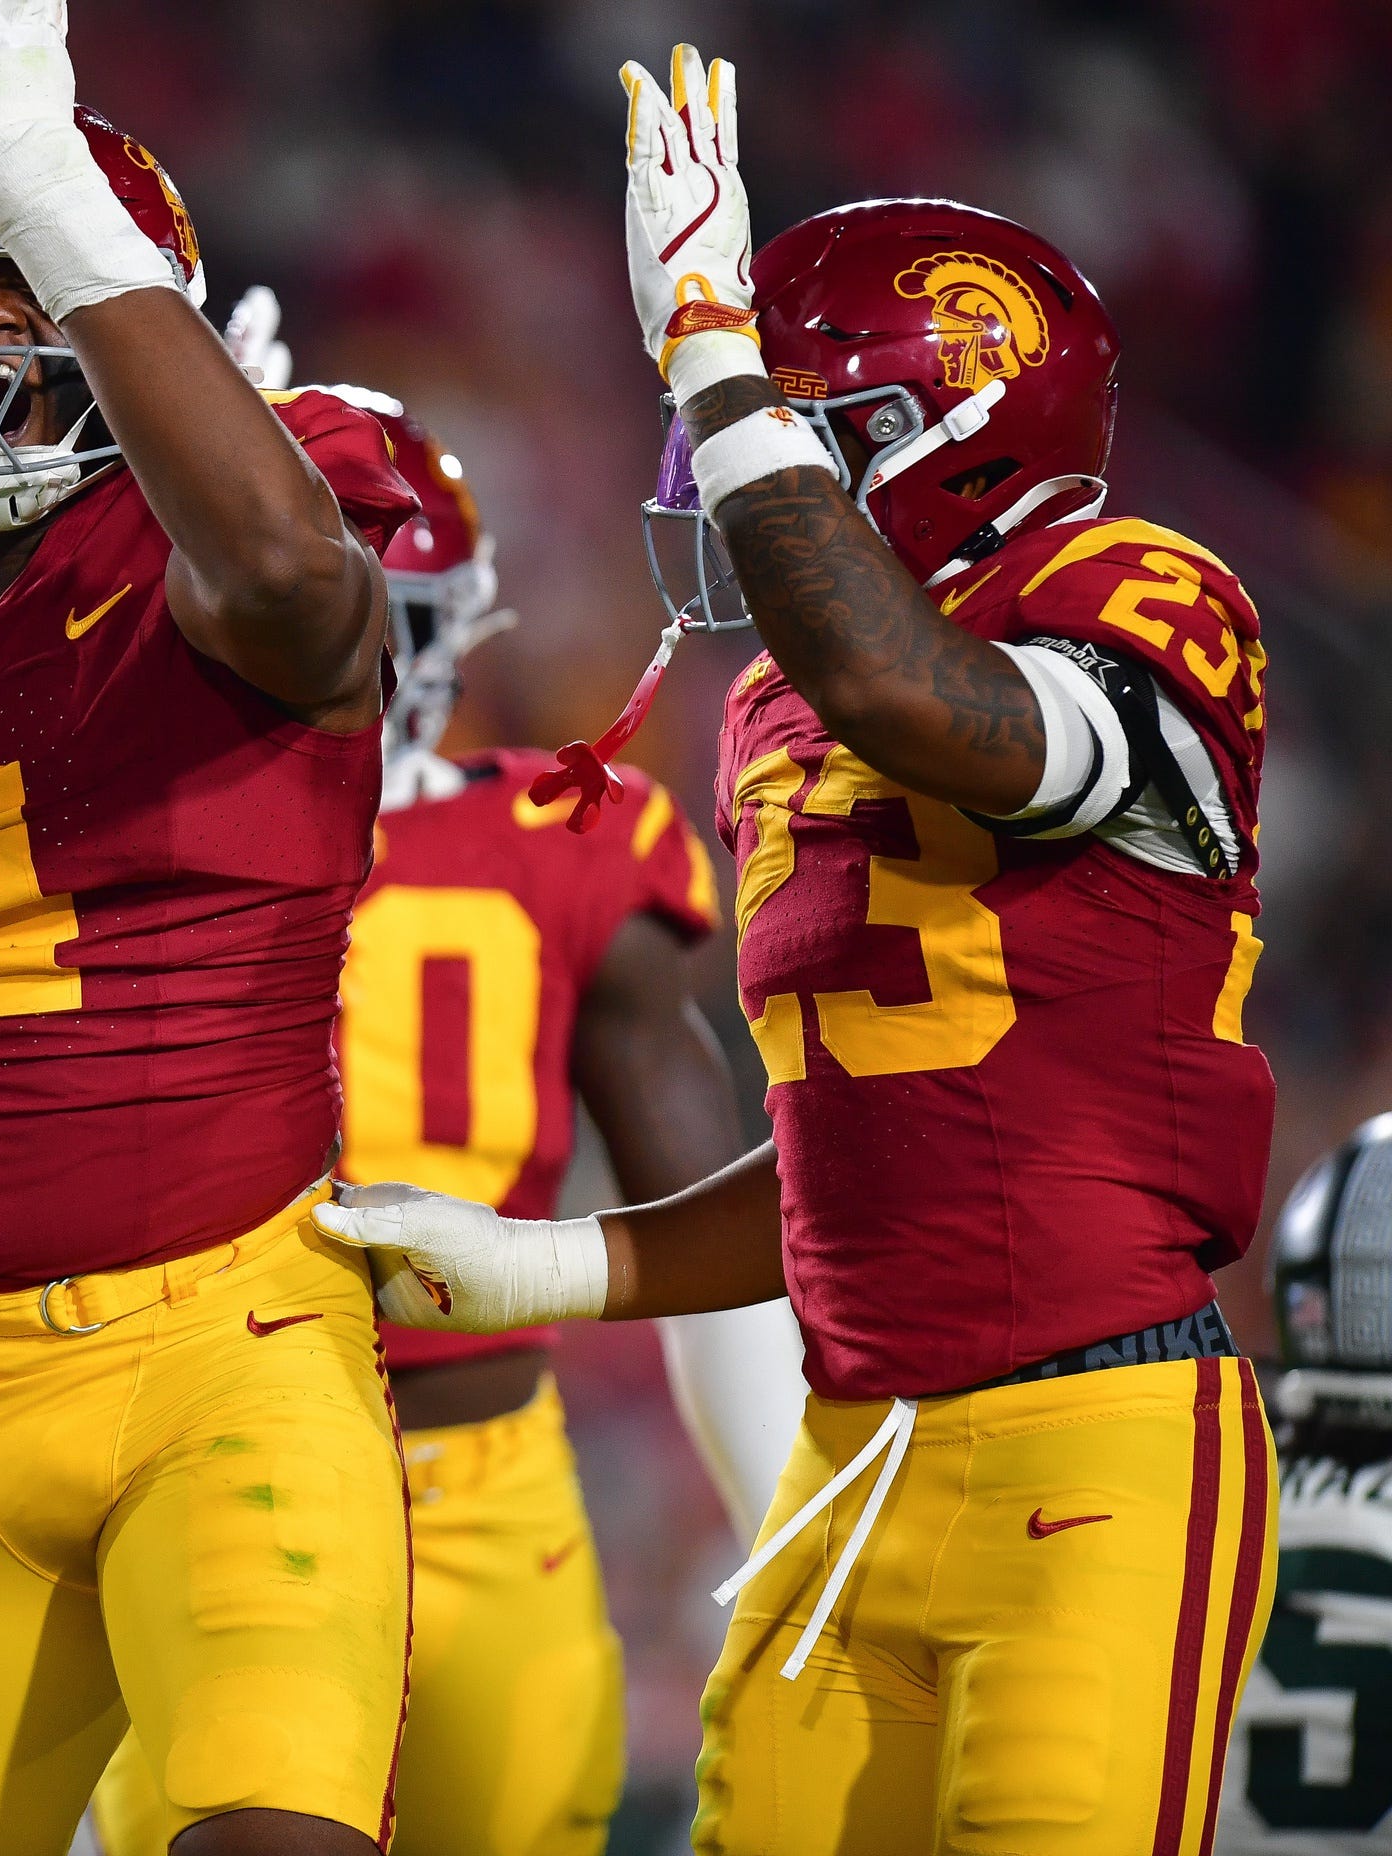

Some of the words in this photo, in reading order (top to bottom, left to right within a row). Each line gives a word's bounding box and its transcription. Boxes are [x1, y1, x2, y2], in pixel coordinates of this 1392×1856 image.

[1097, 551, 1242, 698] 23
[733, 743, 1017, 1087] 23
[1084, 1302, 1226, 1372] NIKE
